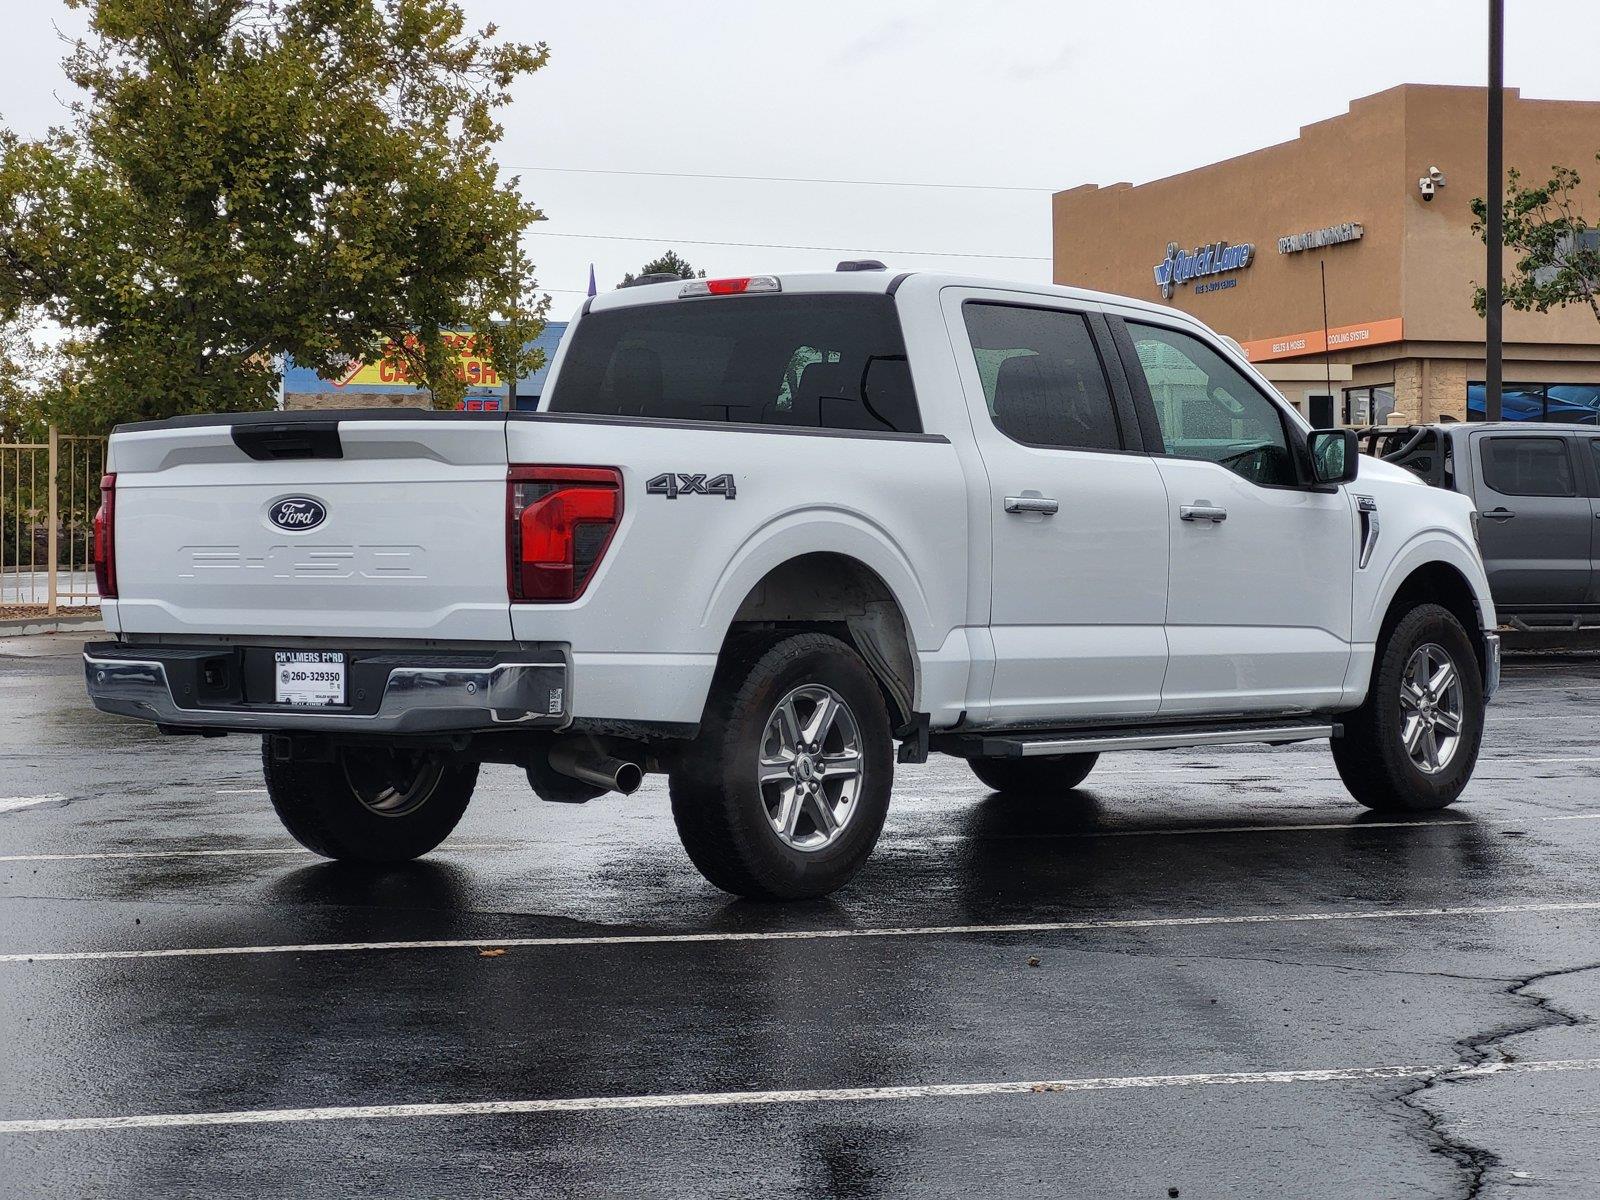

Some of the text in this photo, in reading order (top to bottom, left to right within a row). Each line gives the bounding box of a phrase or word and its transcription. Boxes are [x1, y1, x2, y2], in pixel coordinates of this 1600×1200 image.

[1174, 241, 1251, 284] Quick Lane
[1272, 342, 1286, 353] BELTS
[1290, 339, 1306, 350] HOSES
[1328, 333, 1350, 345] COOLING
[1350, 329, 1369, 342] SYSTEM
[278, 502, 315, 524] Ford
[291, 671, 340, 682] 26D-329350
